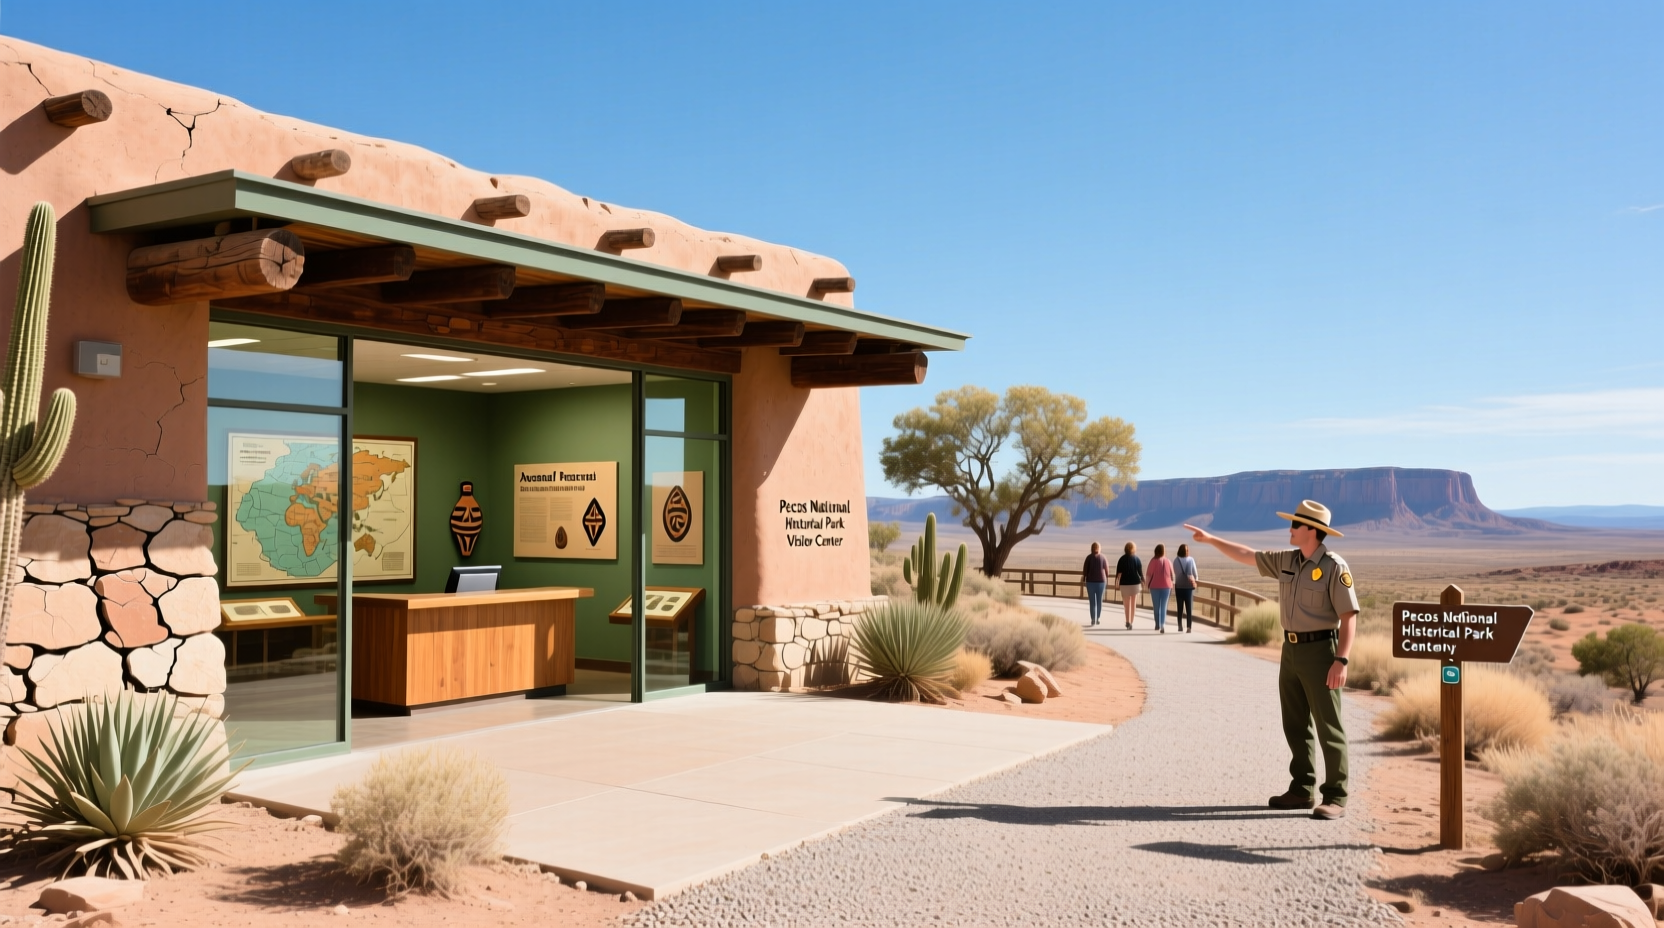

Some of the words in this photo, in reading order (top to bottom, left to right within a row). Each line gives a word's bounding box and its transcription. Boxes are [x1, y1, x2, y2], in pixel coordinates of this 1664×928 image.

[779, 499, 808, 514] Pecos
[825, 516, 846, 530] Park
[1401, 609, 1439, 623] Pecos
[1464, 626, 1495, 641] Park
